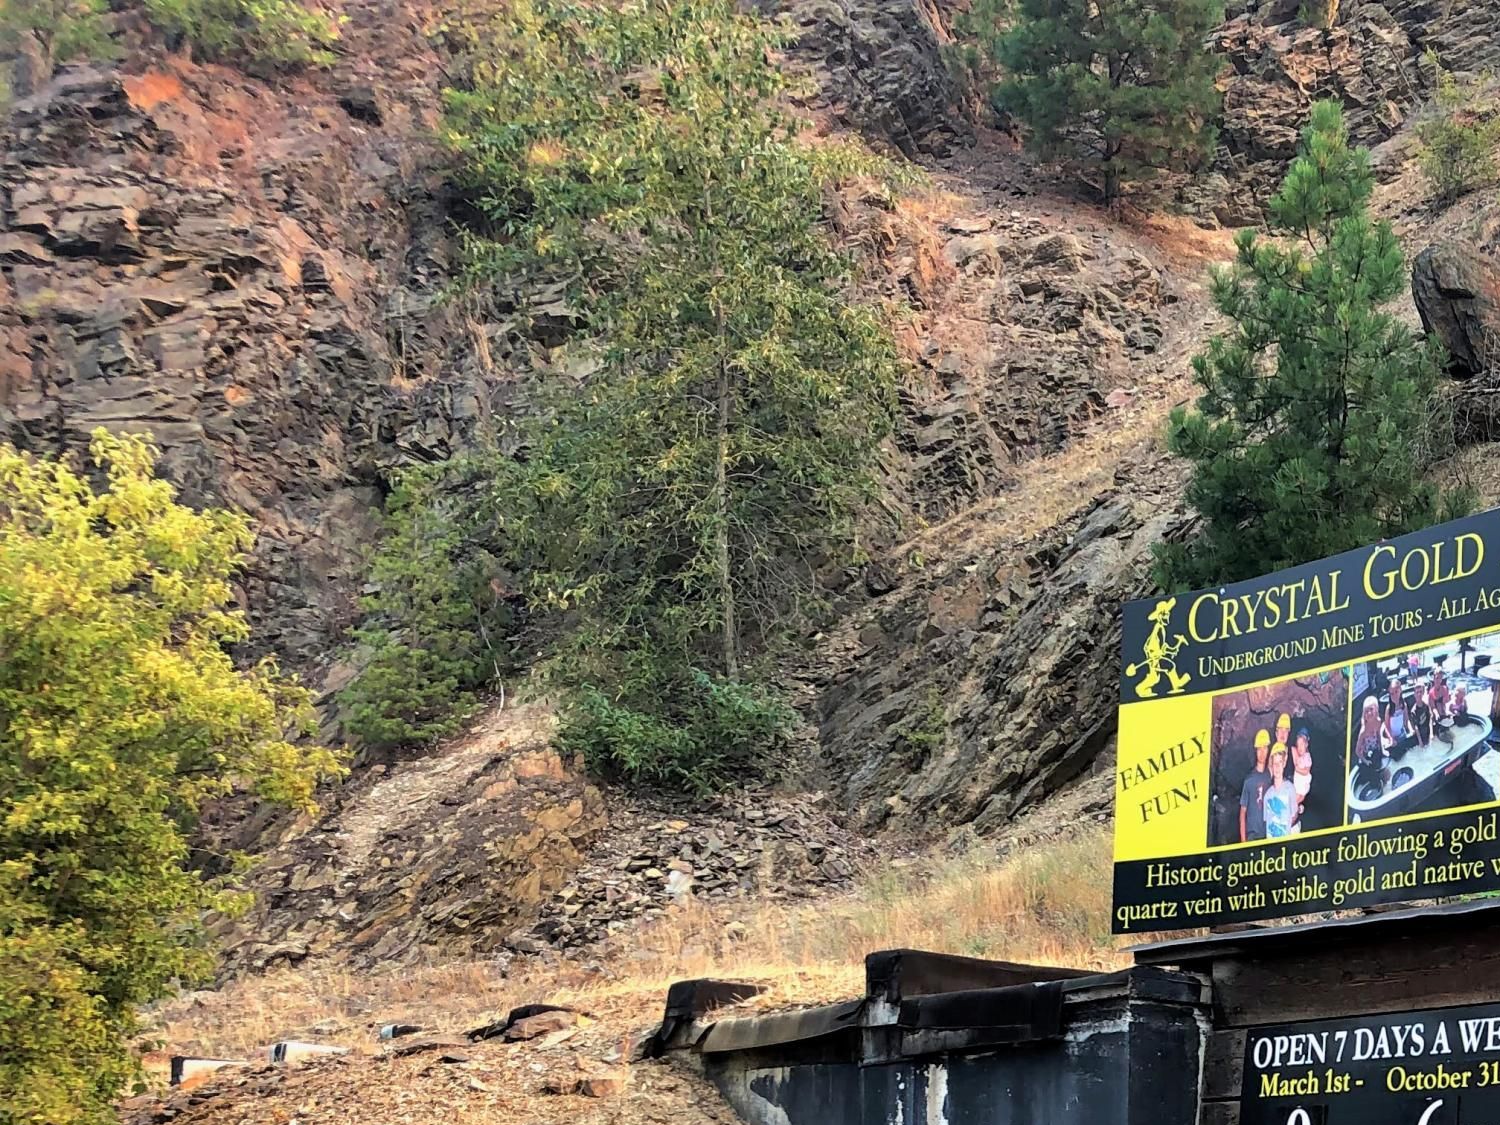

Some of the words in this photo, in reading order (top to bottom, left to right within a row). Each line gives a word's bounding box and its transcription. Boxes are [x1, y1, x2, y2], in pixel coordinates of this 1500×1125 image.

[1188, 570, 1350, 643] CRYSTAL
[1362, 532, 1485, 601] GOLD
[1198, 636, 1317, 678] UNDERGROUND
[1321, 624, 1365, 651] MINE
[1369, 606, 1423, 638] TOURS
[1436, 596, 1471, 622] ALL
[1118, 731, 1208, 792] FAMILY
[1139, 780, 1199, 825] FUN!
[1146, 859, 1223, 887] Historic
[1227, 847, 1286, 887] guided
[1292, 847, 1330, 867] tour
[1336, 828, 1428, 863] following
[1433, 830, 1444, 848] a
[1449, 812, 1497, 854] gold
[1117, 900, 1177, 929] quartz
[1183, 891, 1222, 916] vein
[1228, 882, 1266, 911] with
[1271, 875, 1328, 905] visible
[1333, 866, 1375, 905] gold
[1381, 860, 1417, 890] and
[1423, 855, 1485, 885] native
[1253, 1032, 1328, 1068] OPEN
[1334, 1030, 1347, 1060] 7
[1351, 1022, 1424, 1060] DAYS
[1430, 1021, 1452, 1054] A
[1258, 1068, 1319, 1098] March
[1323, 1067, 1350, 1093] 1st
[1386, 1064, 1471, 1092] October
